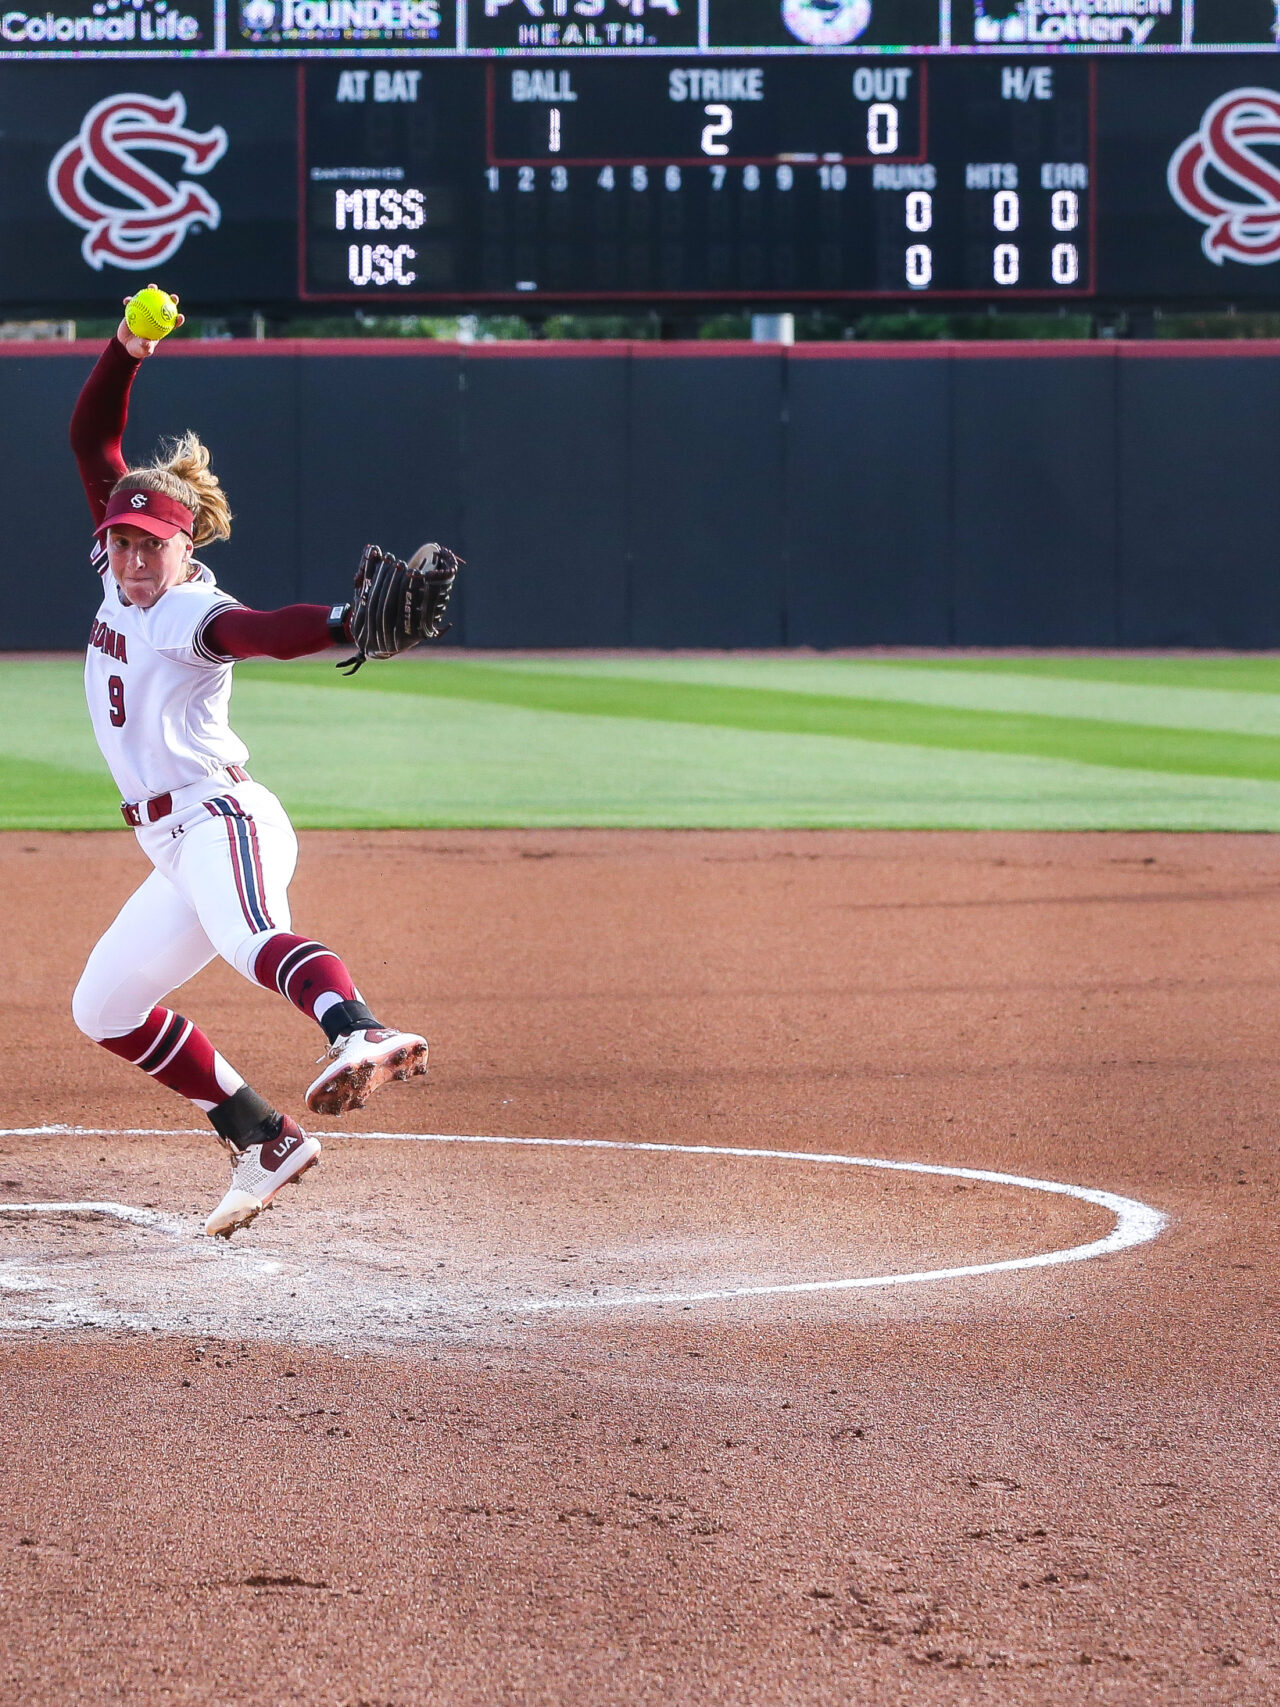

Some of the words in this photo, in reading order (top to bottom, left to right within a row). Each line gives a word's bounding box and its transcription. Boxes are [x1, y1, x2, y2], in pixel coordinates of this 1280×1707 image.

[0, 11, 135, 41] Colonial
[140, 9, 199, 41] Life
[1027, 15, 1157, 44] Lottery
[336, 70, 370, 102] AT
[373, 70, 422, 102] BAT
[511, 69, 577, 102] BALL
[668, 68, 764, 101] STRIKE
[852, 67, 913, 101] OUT
[1001, 66, 1054, 101] H/E
[548, 107, 561, 152] 1
[701, 104, 733, 156] 2
[867, 102, 899, 155] 0
[484, 166, 499, 192] 1
[518, 165, 535, 192] 2
[550, 165, 568, 192] 3
[597, 164, 615, 192] 4
[630, 164, 649, 192] 5
[664, 164, 682, 192] 6
[709, 164, 727, 192] 7
[742, 164, 761, 192] 8
[775, 164, 794, 192] 9
[817, 163, 848, 192] 10
[872, 163, 937, 190] RUNS
[965, 162, 1019, 190] HITS
[1040, 162, 1089, 190] ERR
[335, 188, 426, 230] MISS
[905, 191, 933, 232] 0
[993, 190, 1020, 232] 0
[1051, 190, 1079, 232] 0
[348, 244, 417, 286] USC
[905, 244, 933, 286] 0
[993, 243, 1020, 285] 0
[1051, 242, 1079, 285] 0
[108, 675, 126, 728] 9
[273, 1136, 298, 1158] UA
